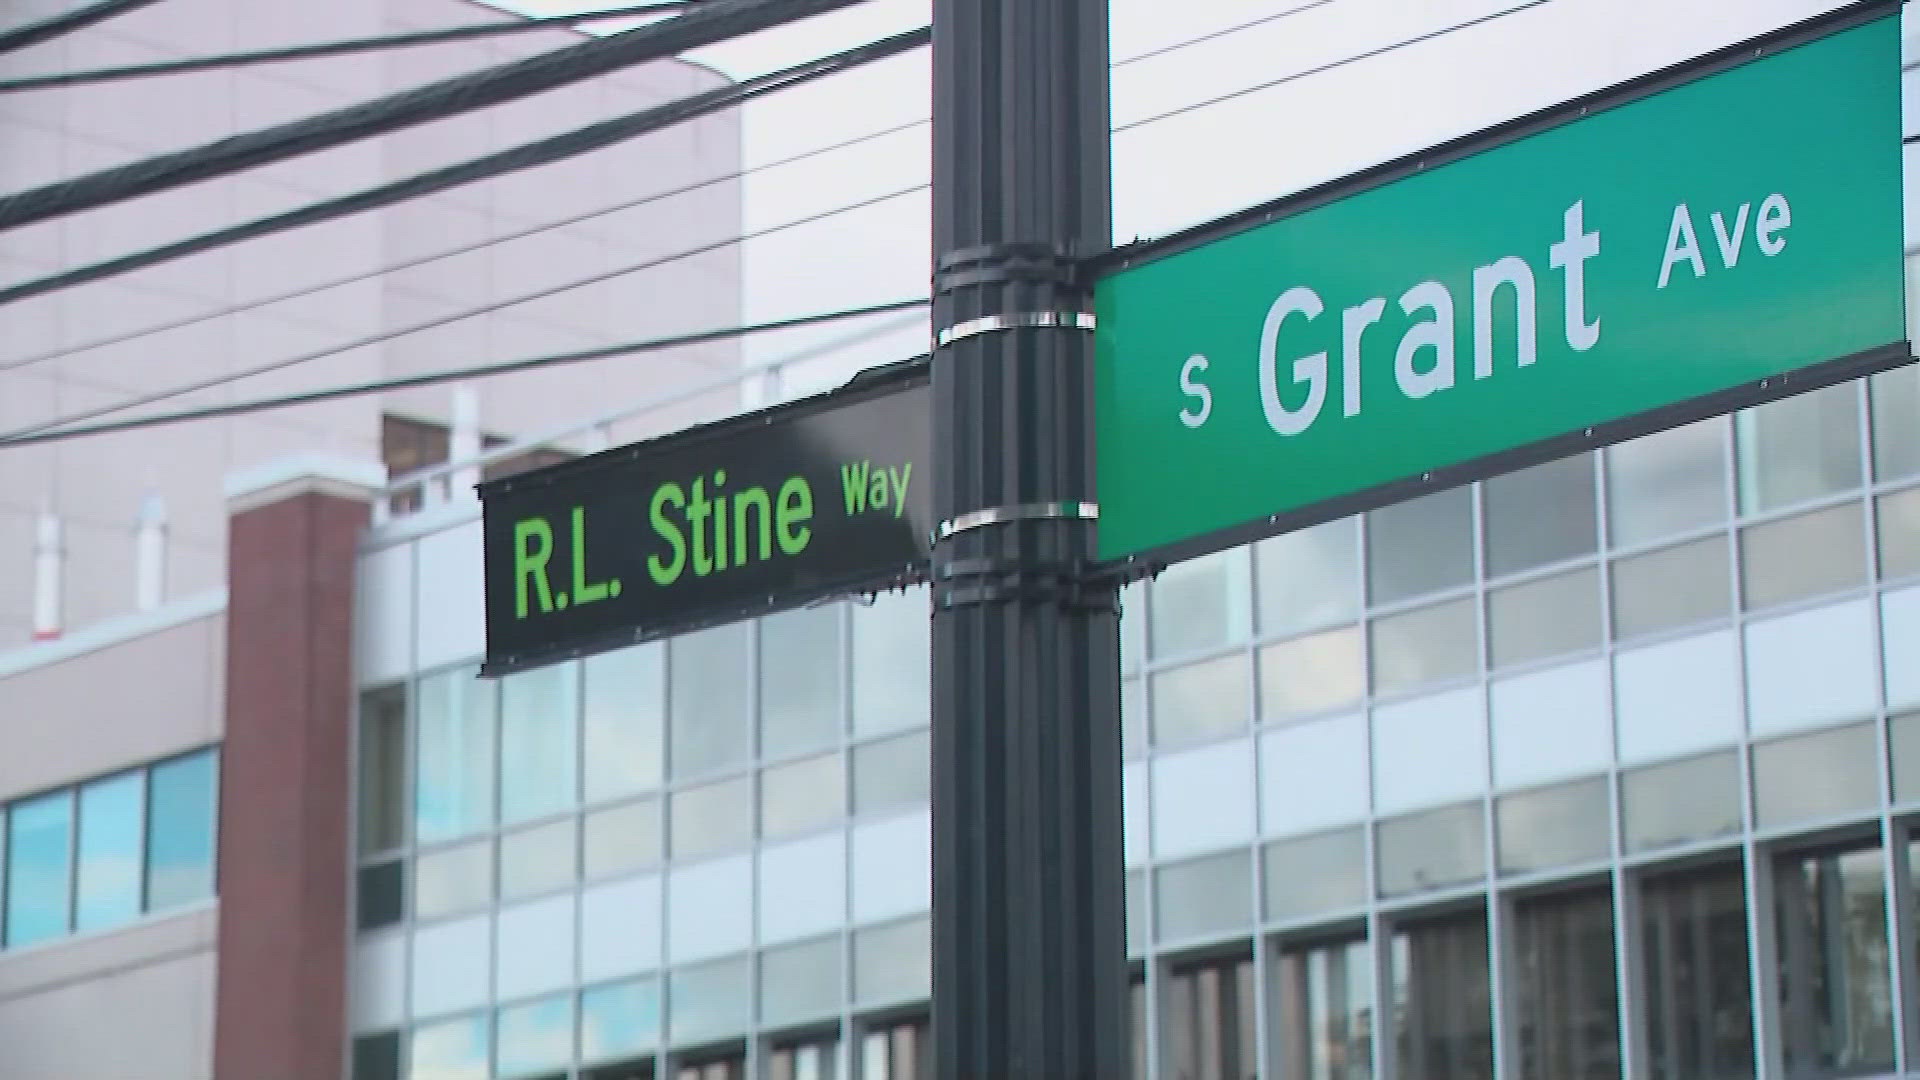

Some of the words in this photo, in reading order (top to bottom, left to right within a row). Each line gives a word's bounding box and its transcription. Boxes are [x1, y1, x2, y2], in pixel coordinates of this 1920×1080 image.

[1178, 352, 1213, 428] S
[1258, 198, 1601, 436] Grant
[1656, 192, 1792, 289] Ave
[514, 506, 622, 620] R.L.
[647, 468, 814, 587] Stine
[840, 460, 912, 519] Way
